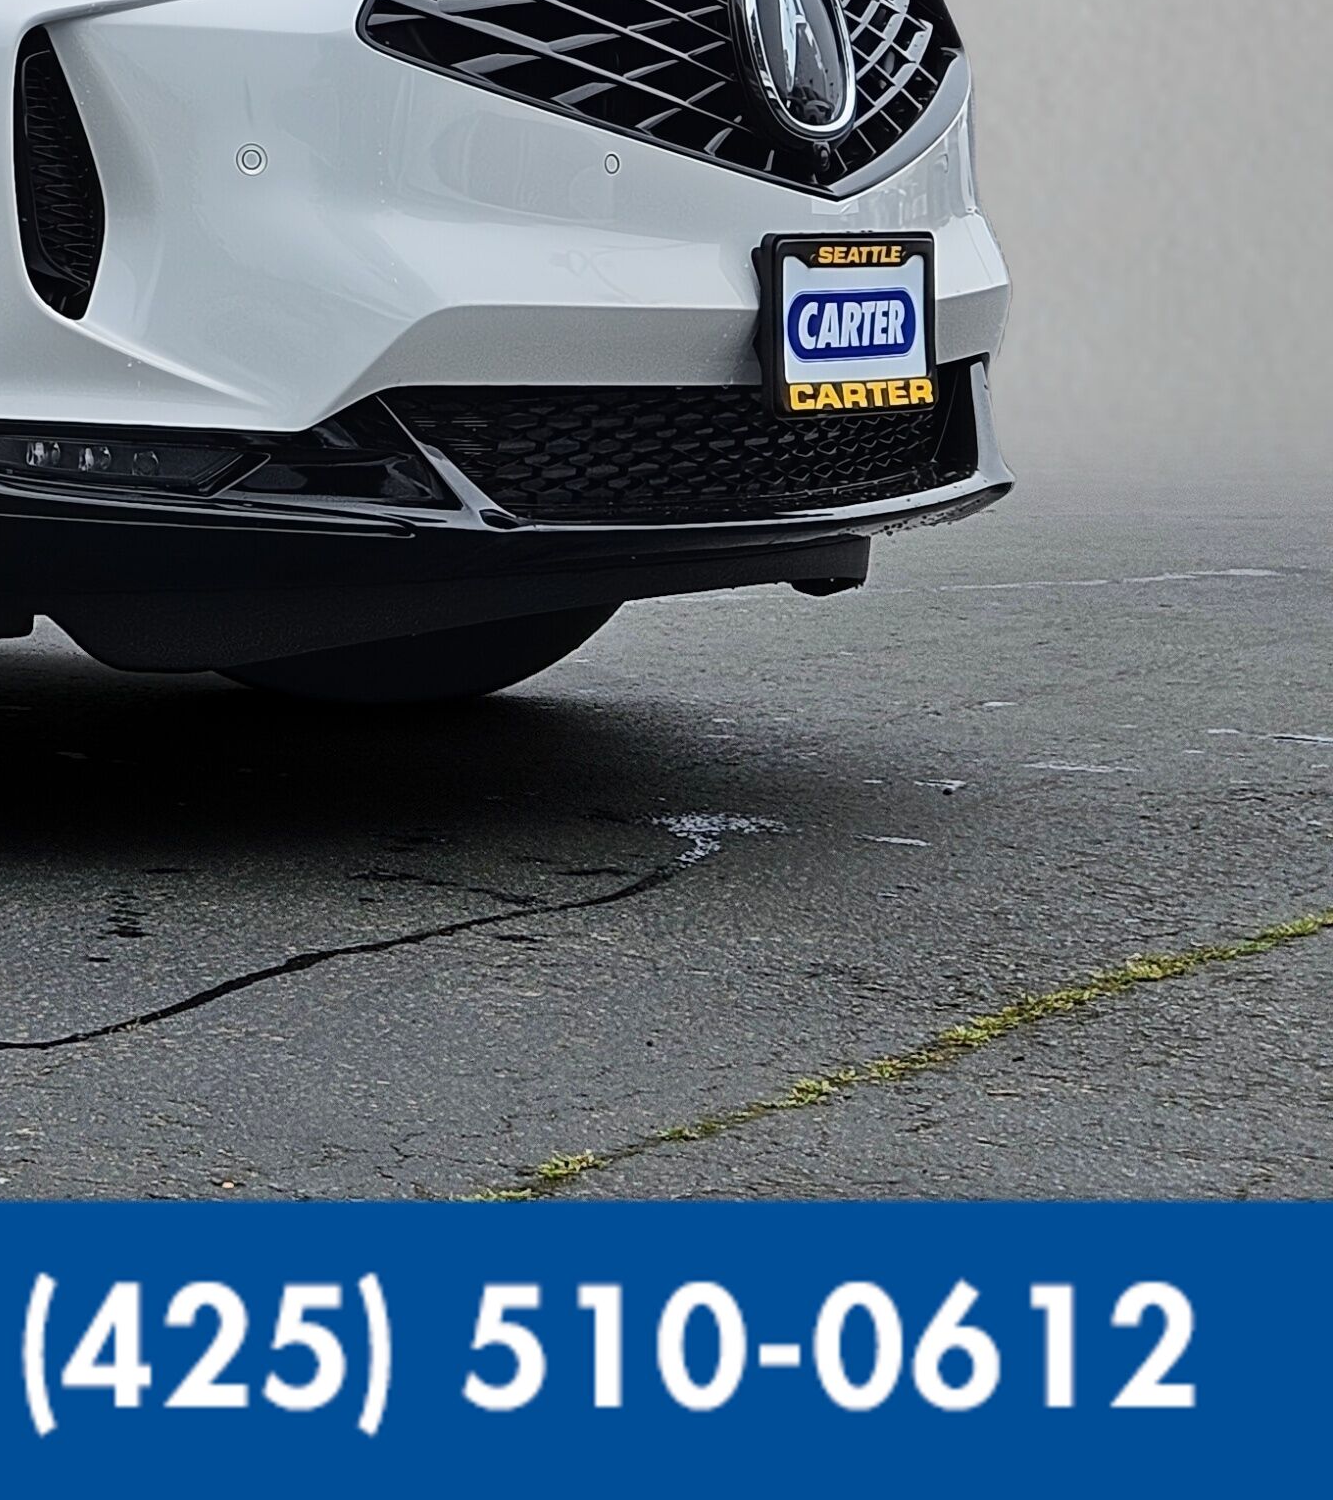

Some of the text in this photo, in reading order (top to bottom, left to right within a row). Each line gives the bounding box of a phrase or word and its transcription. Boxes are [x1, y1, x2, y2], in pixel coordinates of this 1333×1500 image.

[818, 245, 903, 264] SEATTLE
[797, 299, 905, 350] CARTER
[789, 378, 934, 411] CARTER
